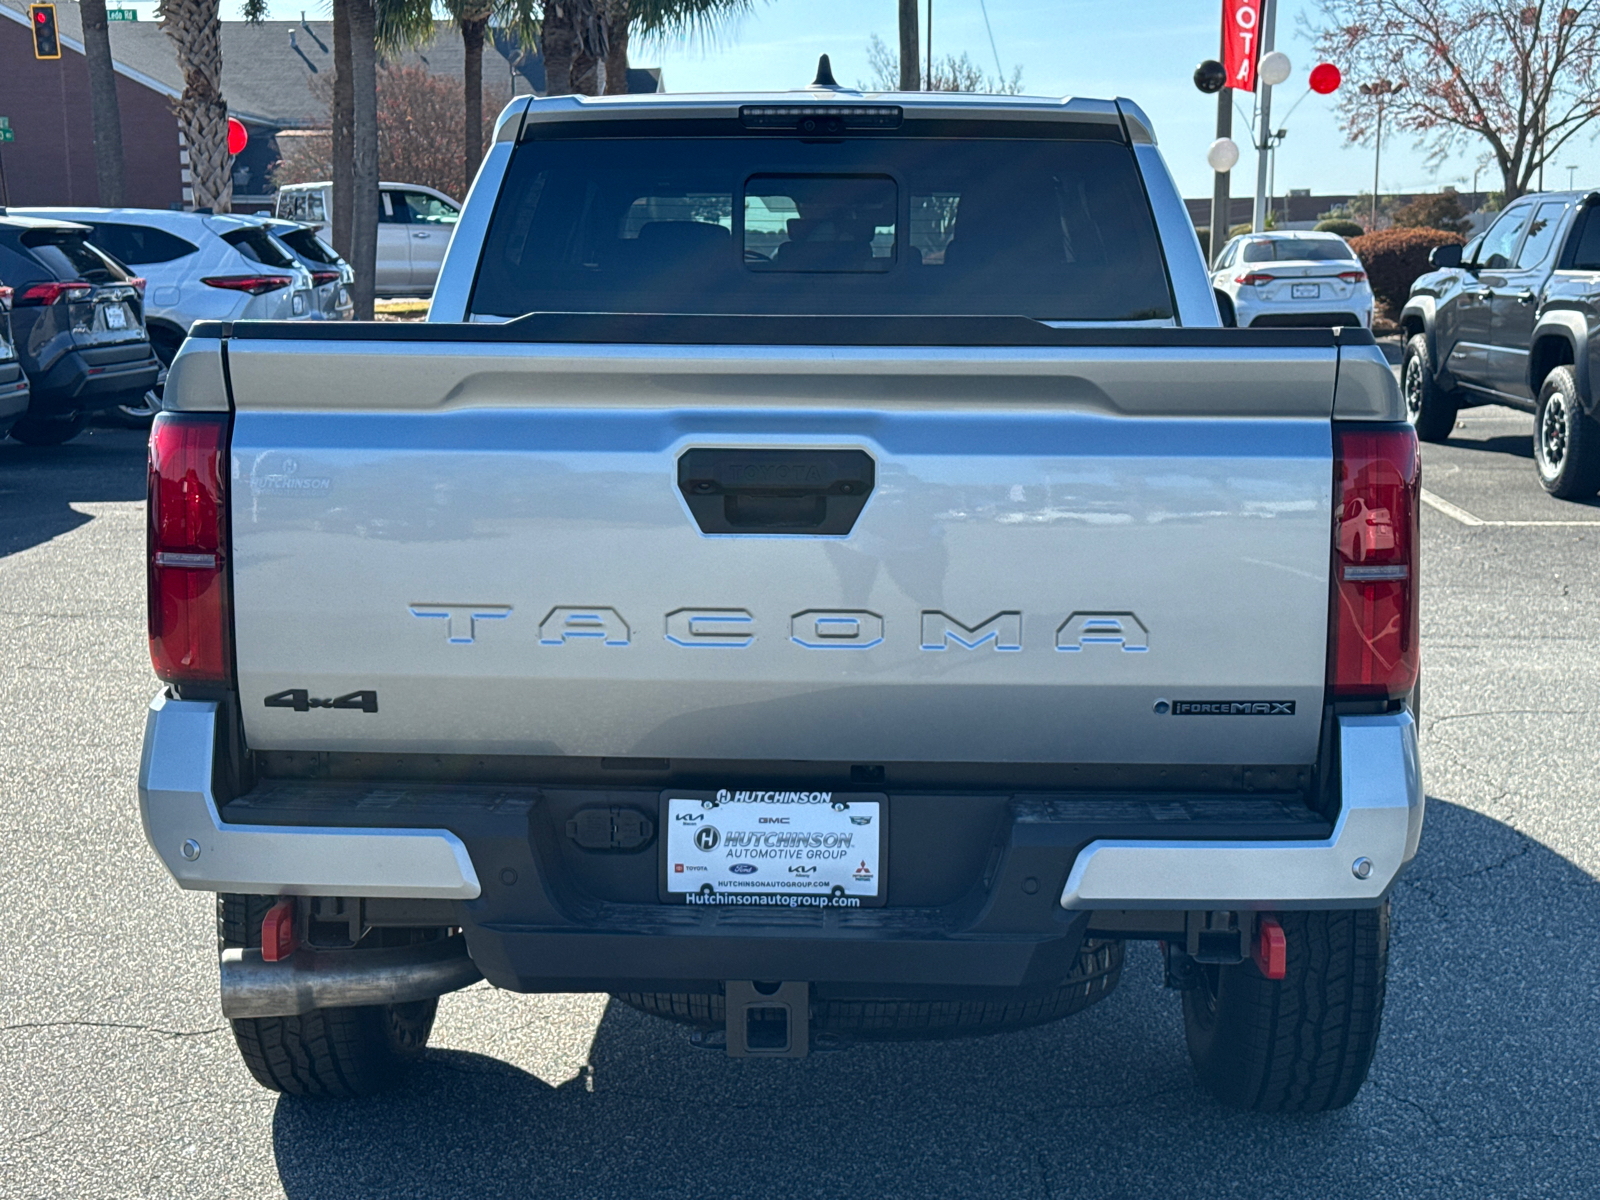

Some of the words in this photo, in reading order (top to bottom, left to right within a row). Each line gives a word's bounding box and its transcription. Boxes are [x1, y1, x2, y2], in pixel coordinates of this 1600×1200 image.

[124, 10, 133, 20] Rd
[1236, 0, 1256, 82] OTA
[730, 464, 821, 481] TOYOTA
[408, 602, 1149, 651] TACOMA
[734, 791, 832, 804] HUTCHINSON
[676, 813, 704, 821] KIA
[724, 831, 854, 849] HUTCHINSON
[725, 848, 803, 859] AUTOMOTIVE
[806, 849, 847, 860] GROUP
[788, 865, 817, 873] KIA
[718, 880, 830, 888] HUTCHINSONAUTOGROUP.COM
[686, 892, 860, 909] Hutchinsonautogroup.com
